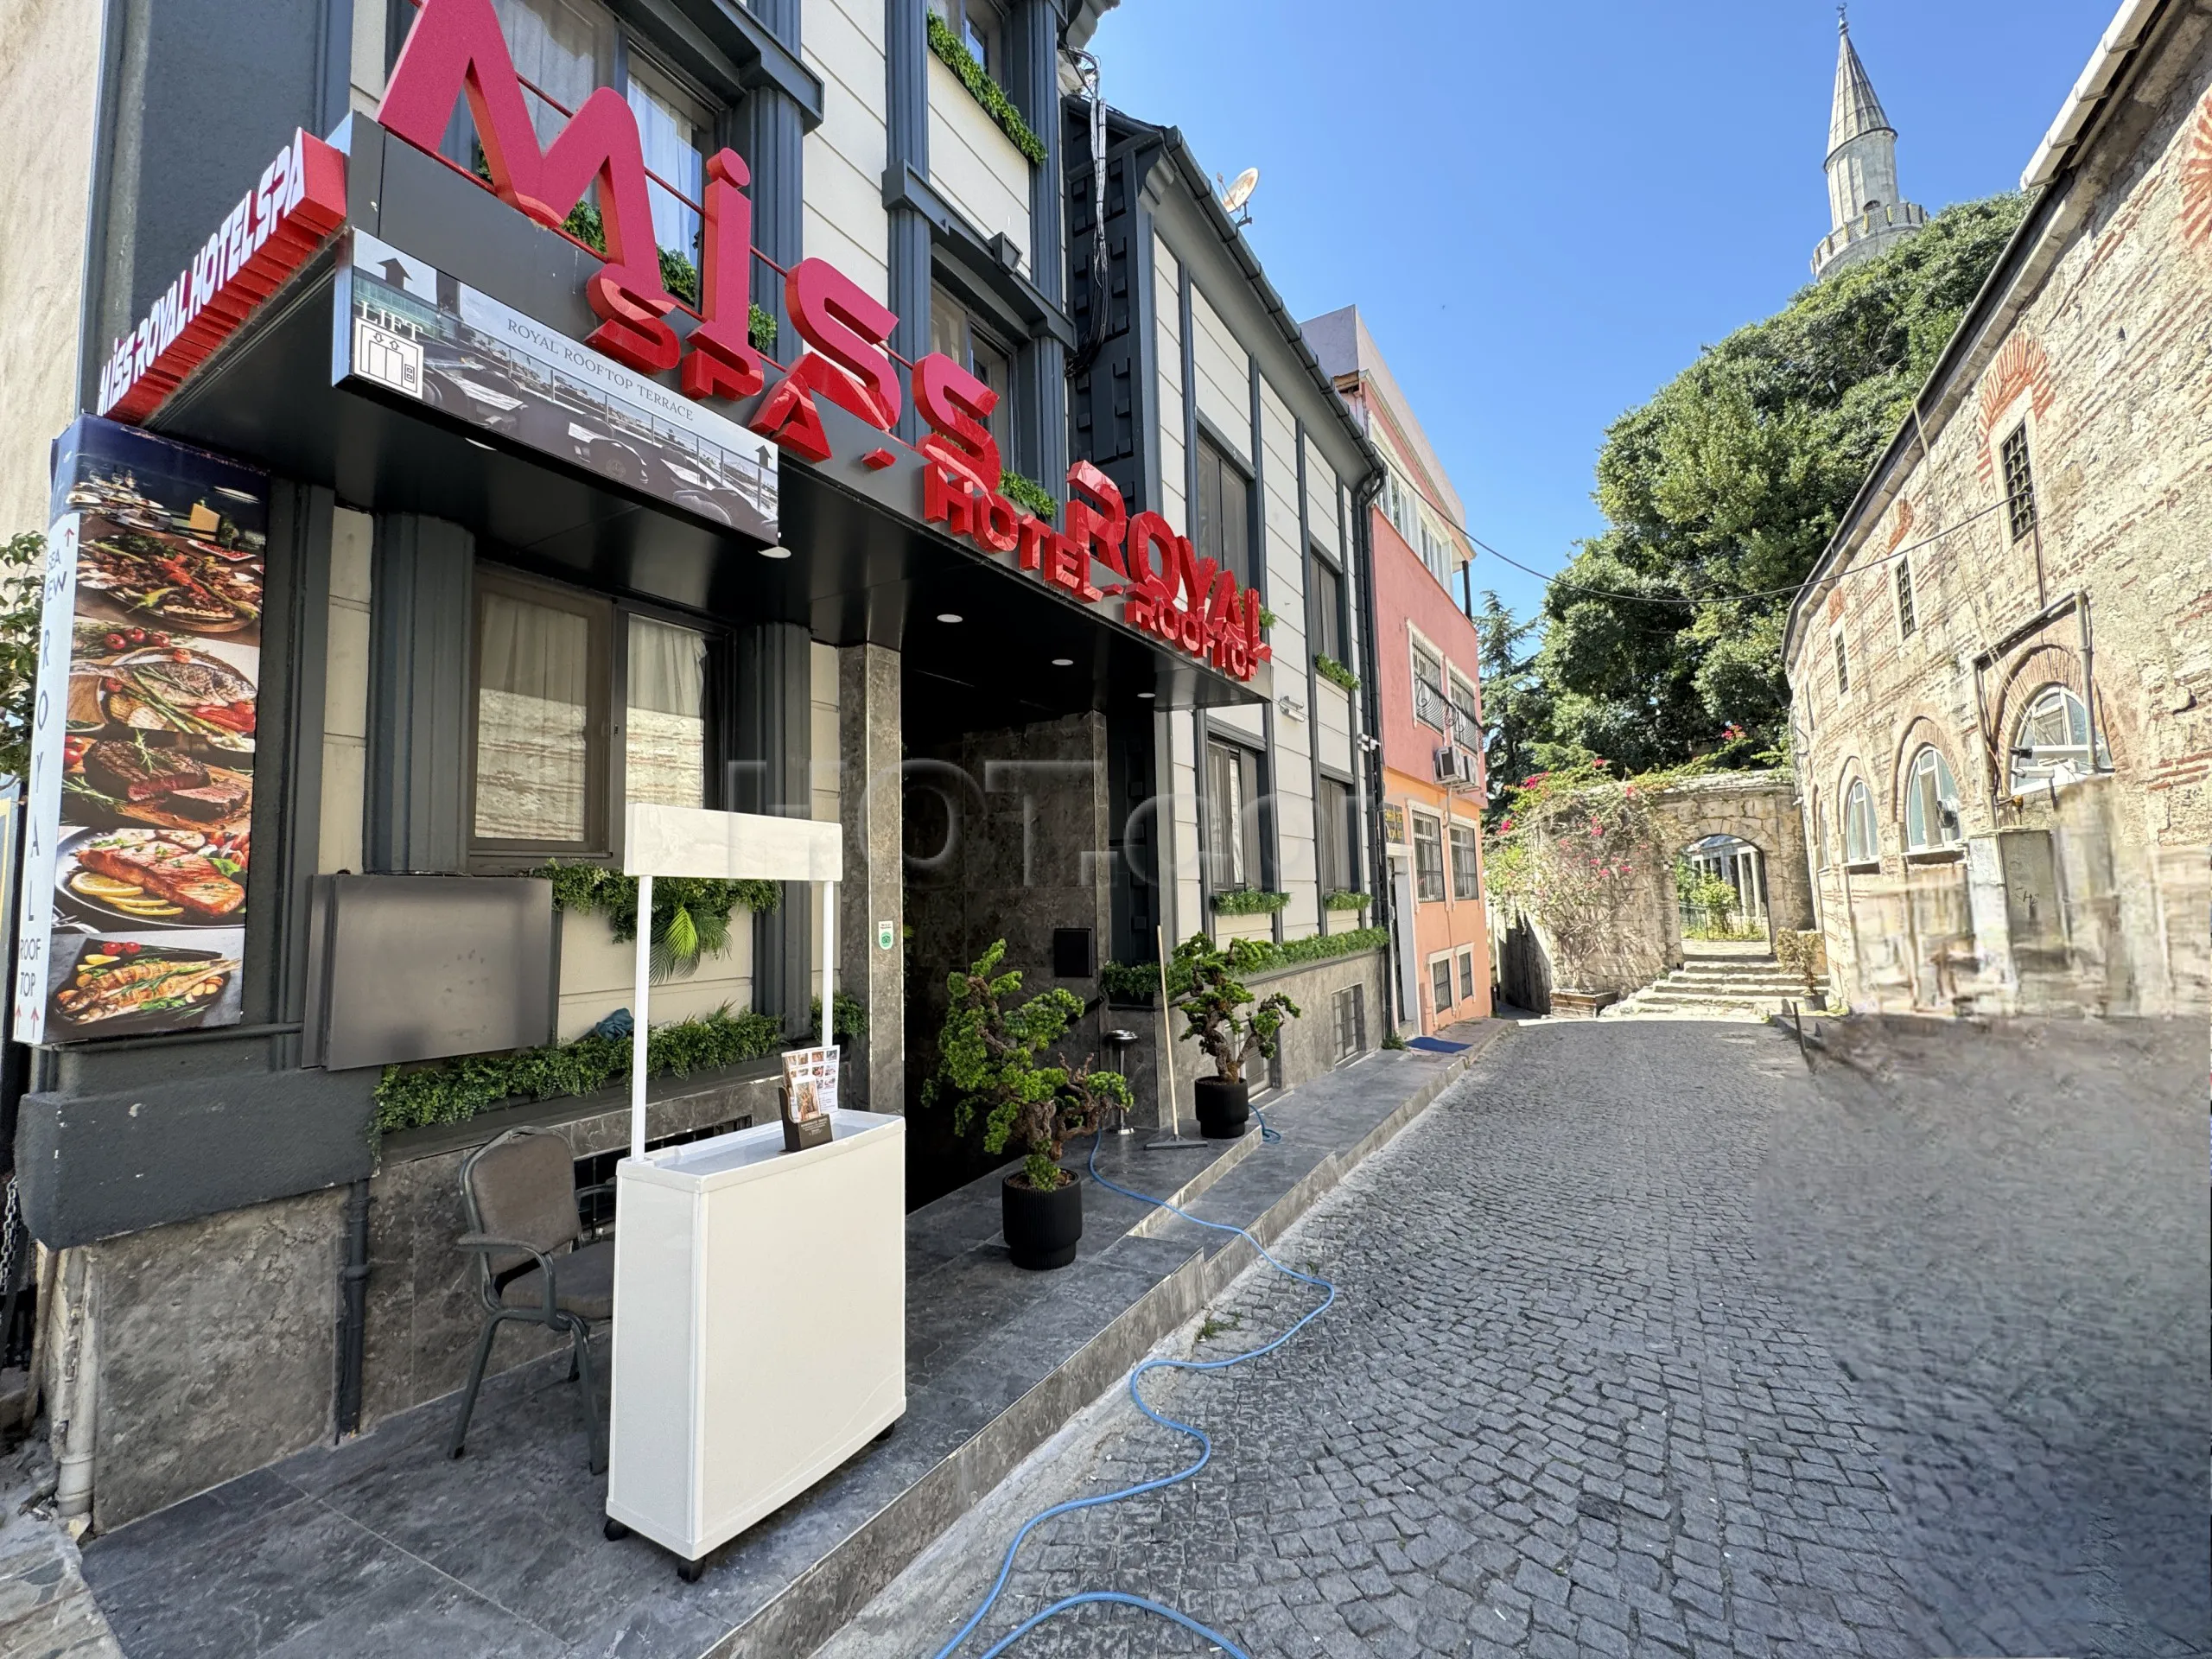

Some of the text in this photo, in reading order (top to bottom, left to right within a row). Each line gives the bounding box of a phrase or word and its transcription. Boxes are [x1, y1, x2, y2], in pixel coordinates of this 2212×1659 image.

[134, 270, 188, 384] ROYAL
[188, 189, 254, 323] HOTEL
[253, 126, 305, 252] SPA
[360, 300, 423, 342] LIFT
[507, 318, 694, 422] ROYAL ROOFTOP TERRACE
[585, 263, 833, 463] SPA
[924, 461, 1104, 603] HOTEL
[1124, 582, 1259, 682] ROOFTOP
[1065, 460, 1273, 664] ROYAL
[19, 938, 41, 961] ROOF
[20, 971, 36, 997] TOP
